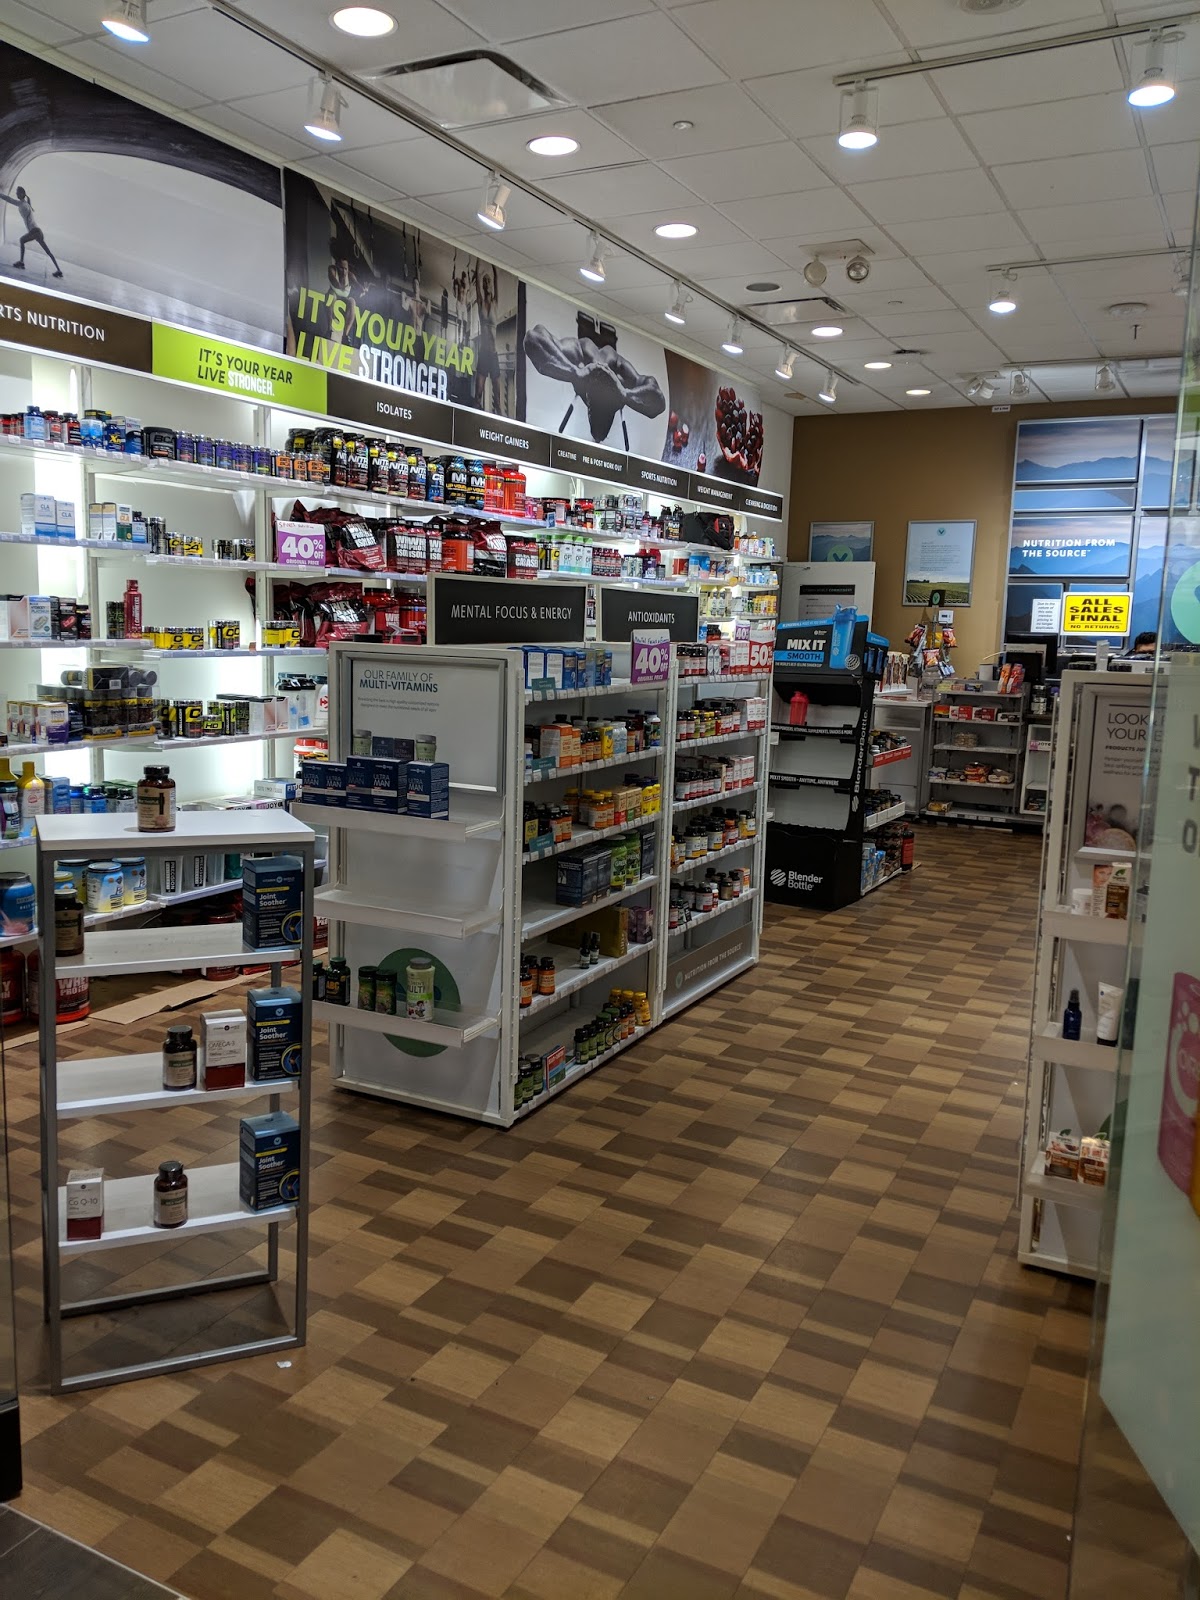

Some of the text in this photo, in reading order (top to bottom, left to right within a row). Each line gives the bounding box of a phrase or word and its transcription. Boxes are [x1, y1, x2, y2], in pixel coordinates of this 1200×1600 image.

[27, 310, 105, 342] NUTRITION
[298, 287, 475, 376] IT'S YOUR YEAR
[295, 331, 355, 372] LIVE
[199, 348, 293, 385] IT'S YOUR YEAR
[197, 364, 226, 384] LIVE
[376, 401, 413, 420] ISOLATES
[479, 428, 529, 450] WEIGHT GAINERS
[557, 449, 577, 461] CREATINE
[641, 470, 678, 487] SPORTS NUTRITION
[1023, 539, 1116, 547] NUTRITION FROM
[314, 551, 325, 560] OFF
[451, 604, 572, 620] MENTAL FOCUS & ENERGY
[1069, 606, 1124, 614] SALES
[628, 611, 675, 624] ANTIOXIDANTS
[787, 639, 811, 651] MIX
[812, 639, 826, 651] IT
[660, 662, 669, 672] OFF
[364, 669, 434, 683] OUR FAMILY OF
[359, 679, 438, 693] MULTI-VITAMINS
[1108, 712, 1149, 726] LOOK
[1106, 727, 1147, 741] YOUR
[303, 778, 319, 786] MAN
[326, 780, 342, 788] MAN
[348, 777, 365, 785] MAN
[373, 779, 390, 788] MAN
[408, 783, 424, 792] MAN
[788, 870, 823, 883] Blender
[787, 879, 814, 891] Bottle
[259, 893, 277, 901] Joint
[259, 898, 287, 907] Soother
[684, 963, 707, 981] NUTRITION
[707, 955, 719, 968] FROM
[719, 951, 727, 961] THE
[259, 1026, 277, 1034] Joint
[259, 1031, 288, 1040] Soother
[258, 1155, 275, 1165] Joint
[258, 1159, 285, 1170] Soother
